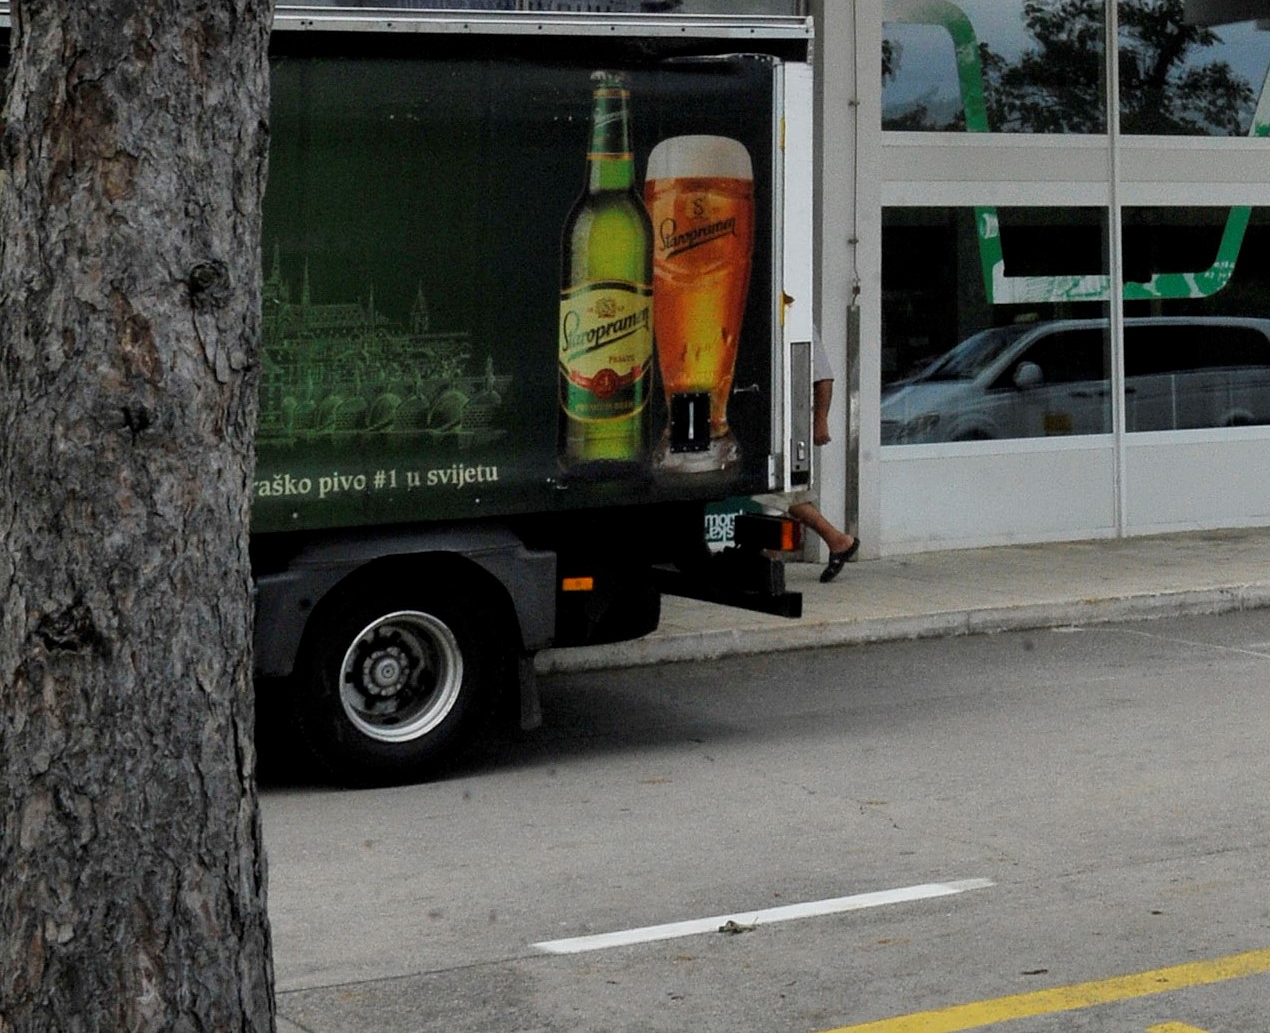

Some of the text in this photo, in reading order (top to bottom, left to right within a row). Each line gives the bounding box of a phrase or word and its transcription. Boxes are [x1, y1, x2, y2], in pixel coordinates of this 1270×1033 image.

[660, 217, 737, 254] Staropramen
[563, 307, 651, 353] Staropramen
[319, 471, 366, 498] pivo
[374, 469, 397, 489] #1
[407, 470, 420, 487] u
[427, 464, 499, 489] svijetu
